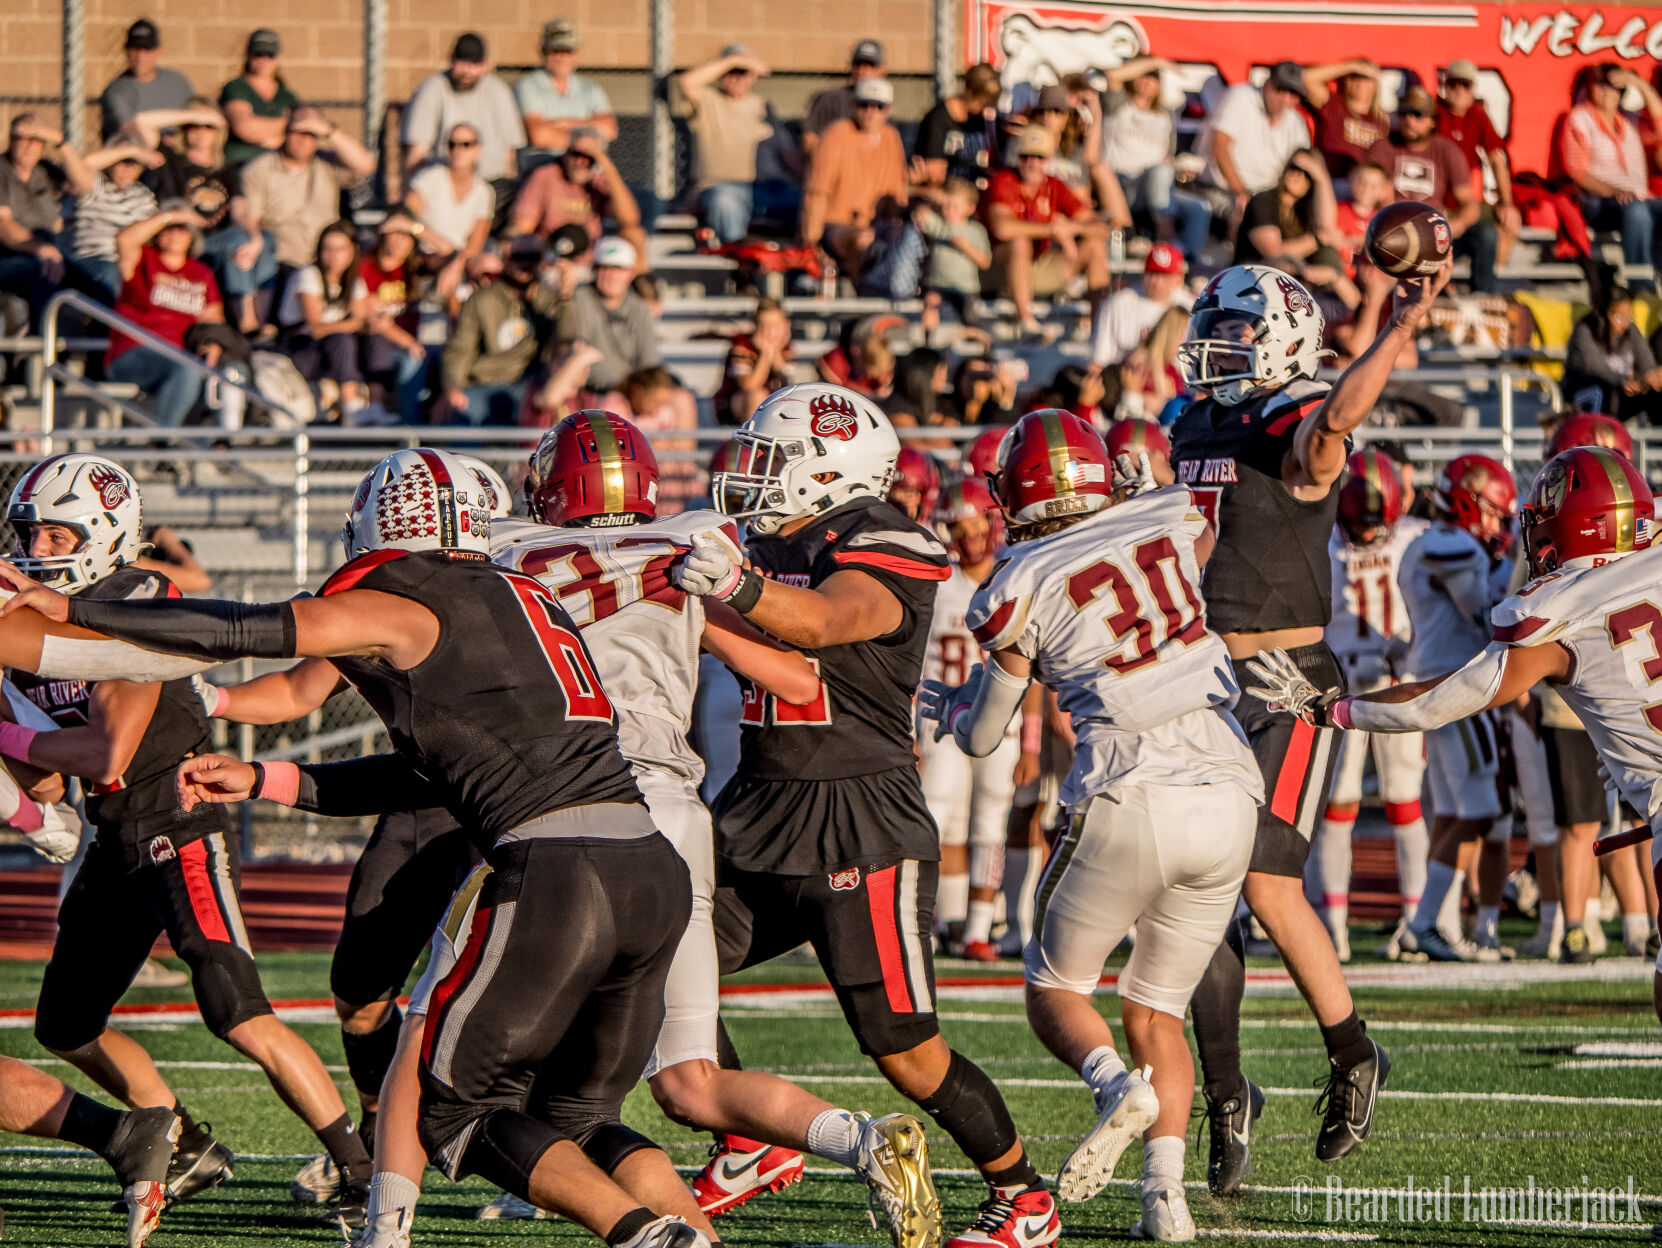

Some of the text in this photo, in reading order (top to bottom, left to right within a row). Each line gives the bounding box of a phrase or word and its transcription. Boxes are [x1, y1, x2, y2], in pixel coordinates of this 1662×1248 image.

[1200, 457, 1239, 482] RIVER
[461, 510, 470, 532] 6
[590, 513, 636, 528] schutt
[1065, 534, 1212, 677] 30
[1350, 574, 1394, 637] 11
[497, 571, 614, 727] 6
[49, 680, 90, 706] RIVER
